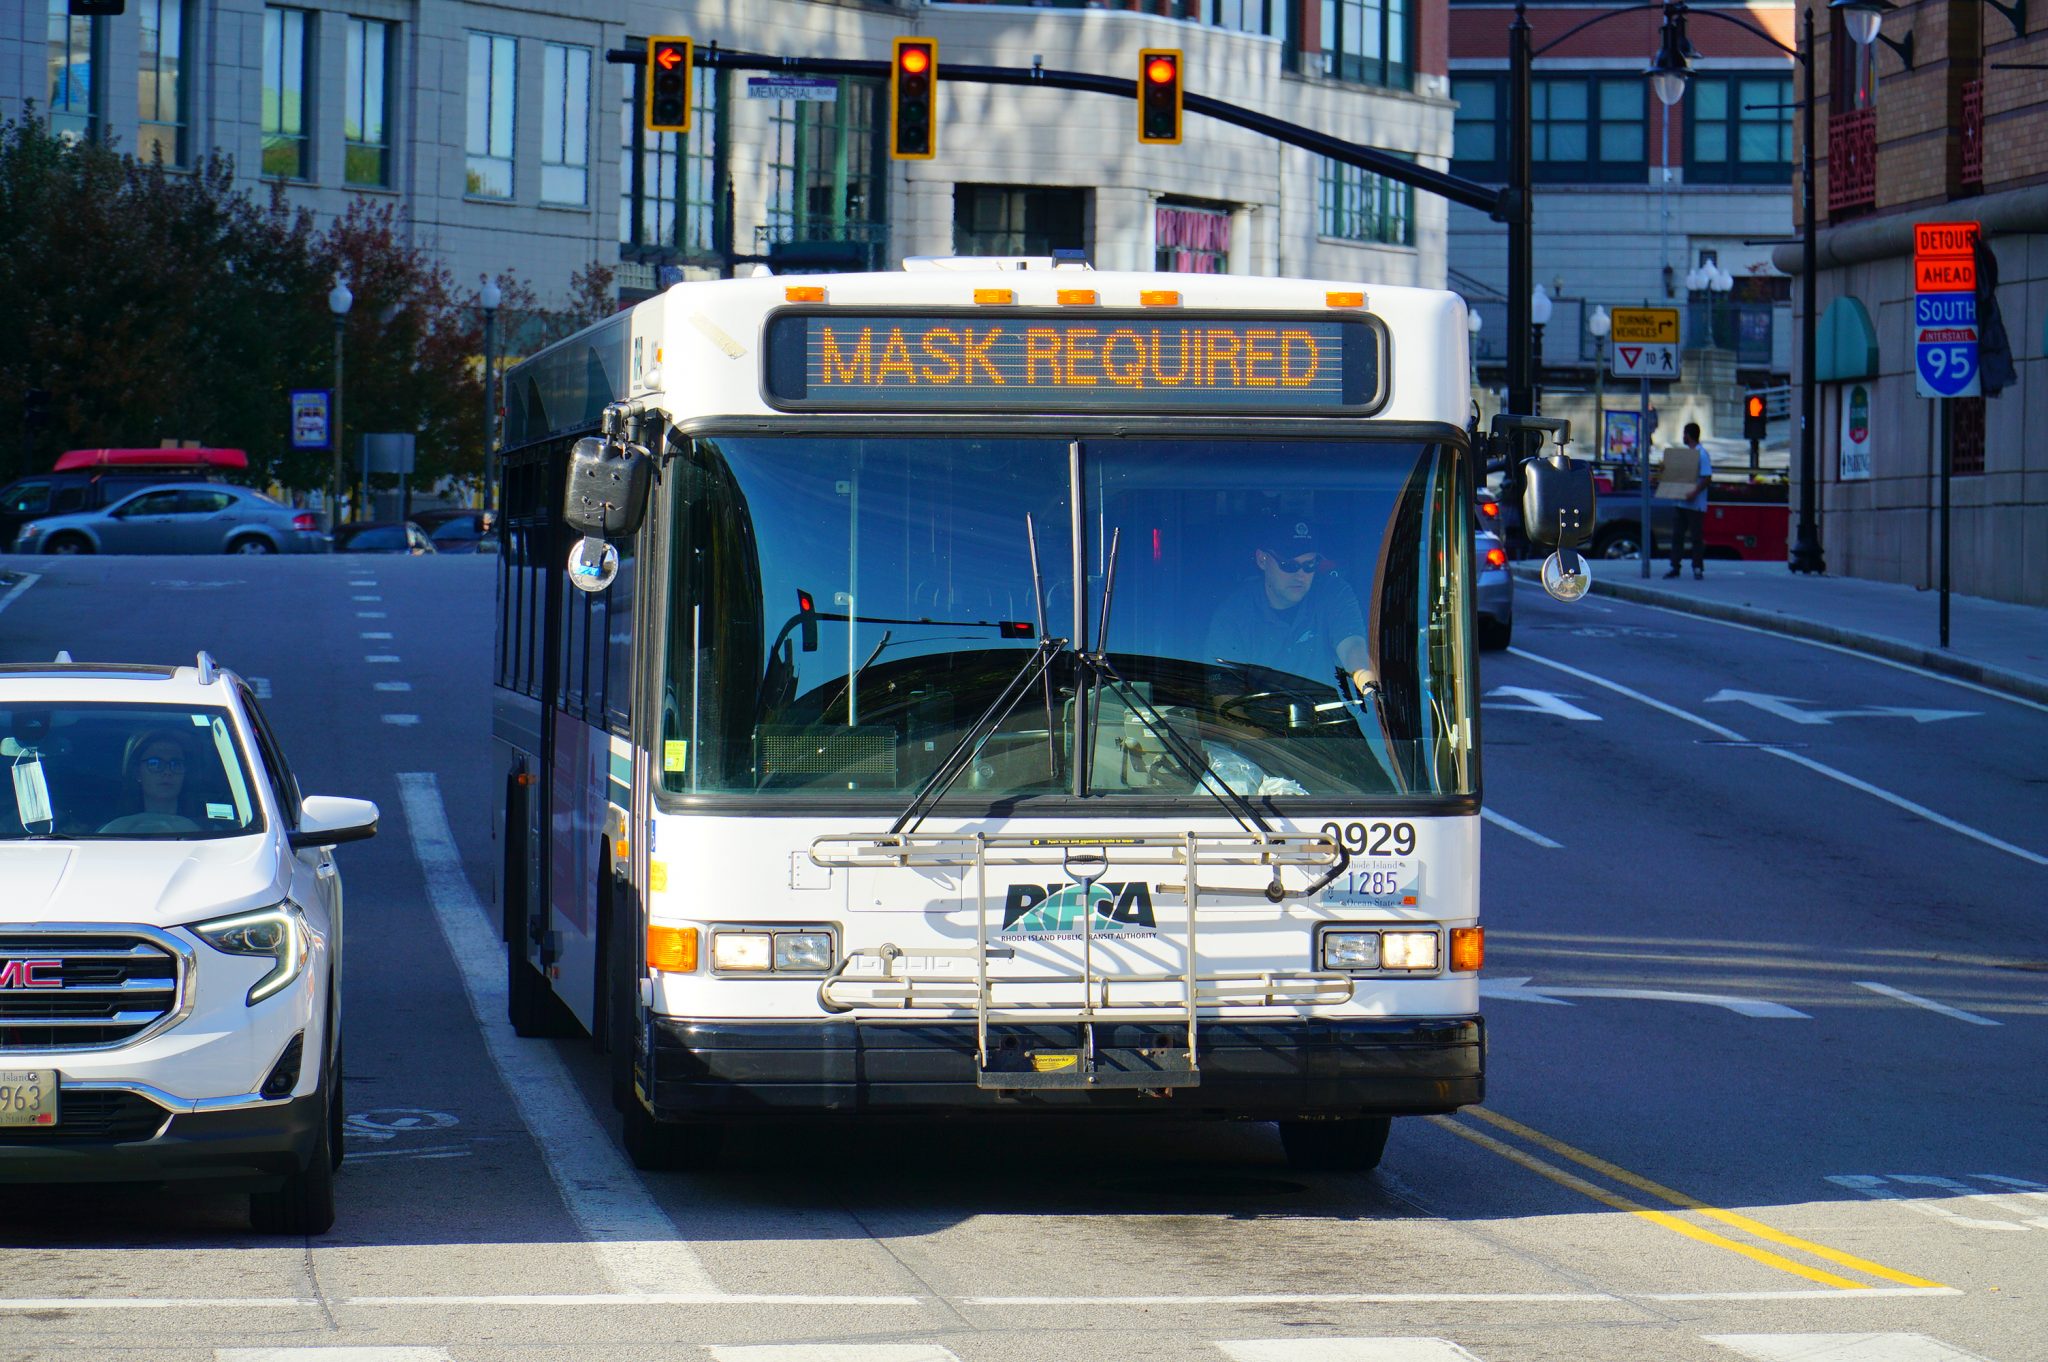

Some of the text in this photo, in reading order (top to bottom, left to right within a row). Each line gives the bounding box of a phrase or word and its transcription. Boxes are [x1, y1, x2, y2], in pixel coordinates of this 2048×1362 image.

[750, 87, 812, 99] MEMORIAL
[1920, 230, 1975, 250] DETOUR
[1923, 267, 1972, 283] AHEAD
[1919, 299, 1977, 321] SOUTH
[1618, 315, 1655, 326] TURNING
[1616, 327, 1657, 337] VEHICLES
[1925, 331, 1970, 341] INTERSTATE
[823, 328, 1319, 389] MASK REQUIRED
[1927, 348, 1970, 379] 95
[1347, 860, 1398, 869] hode Island
[1348, 871, 1397, 895] 1285
[1002, 882, 1156, 931] RIPTA
[1057, 933, 1083, 941] PUBLIC
[1087, 933, 1114, 941] RANSIT
[1115, 932, 1157, 940] AUTHORITY
[3, 1072, 31, 1082] Island
[0, 1086, 40, 1111] 963
